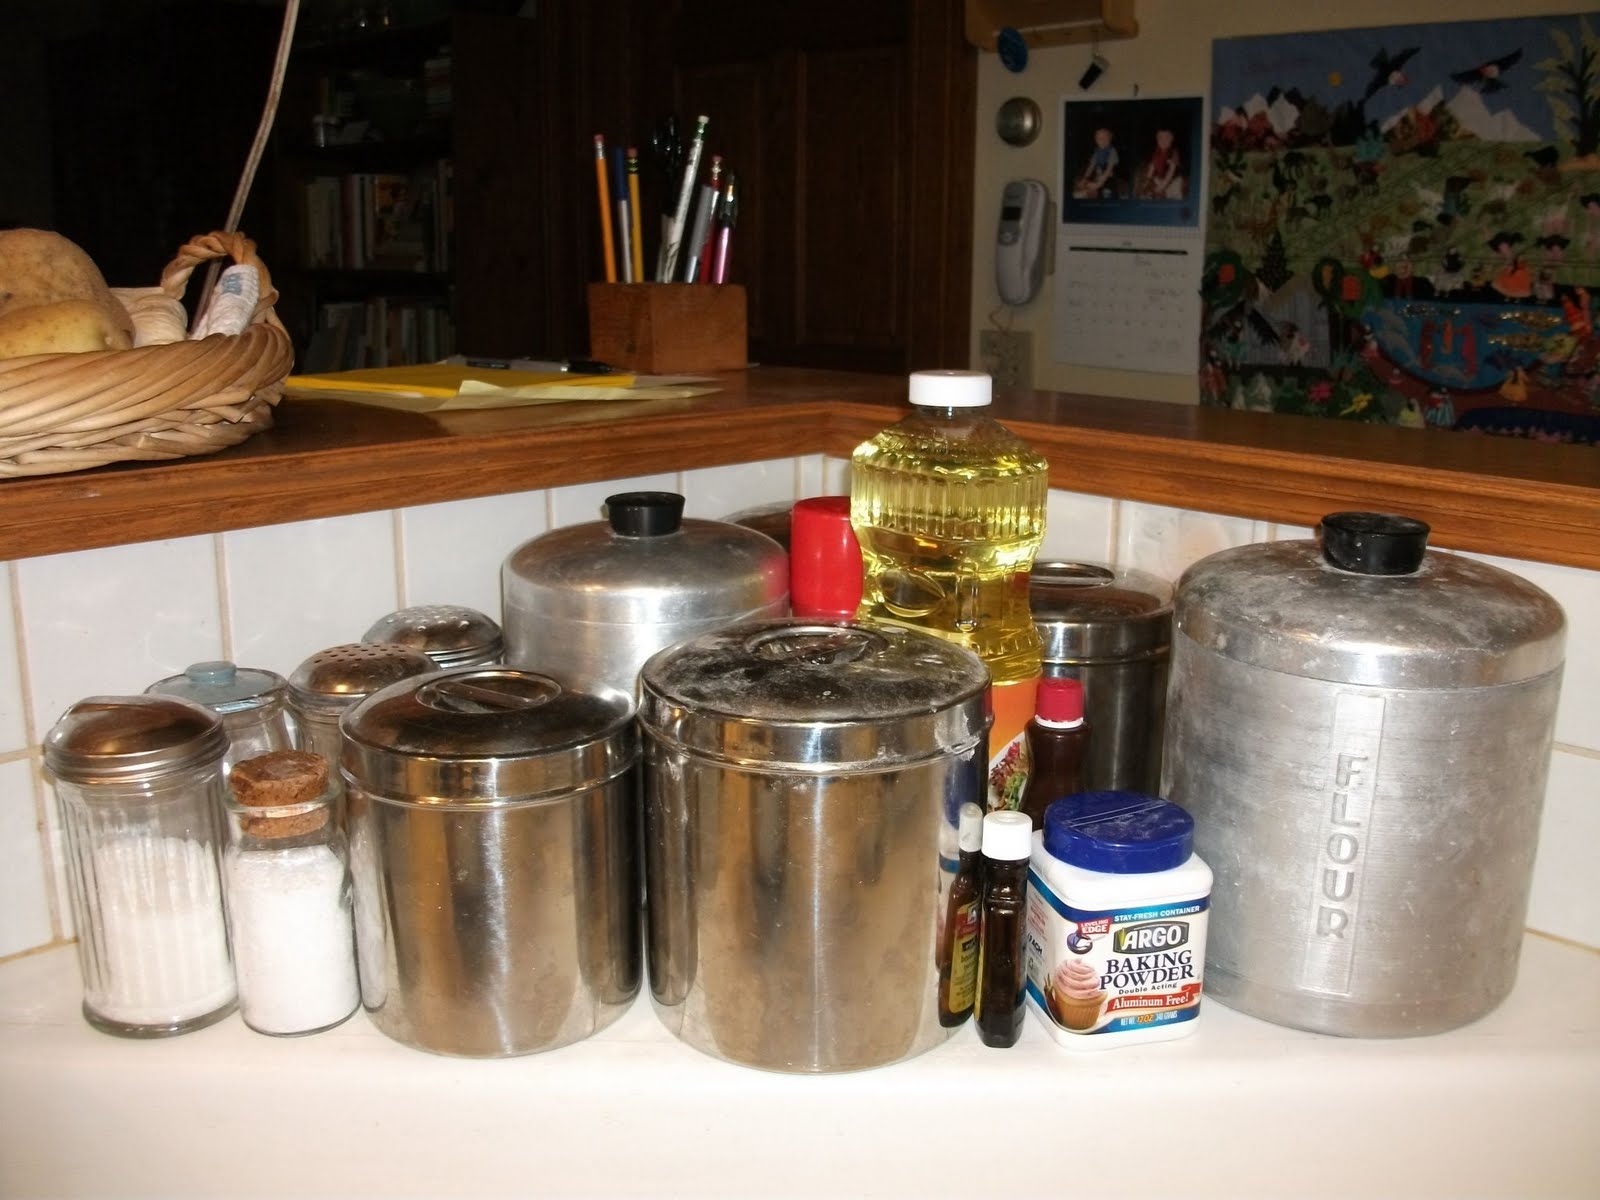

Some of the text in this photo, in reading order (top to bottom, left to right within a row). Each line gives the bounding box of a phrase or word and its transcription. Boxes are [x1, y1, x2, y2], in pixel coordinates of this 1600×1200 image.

[1316, 752, 1368, 938] FLOUR
[1114, 905, 1200, 922] STAY-FRESH CONTAINER
[1081, 919, 1109, 928] LEVELING
[1082, 924, 1108, 934] EDGE
[1121, 925, 1182, 951] ARGO
[1106, 949, 1192, 974] BAKING
[1099, 964, 1195, 990] POWDER
[1118, 982, 1178, 995] Double Acting
[1112, 991, 1189, 1010] Aluminum Free!
